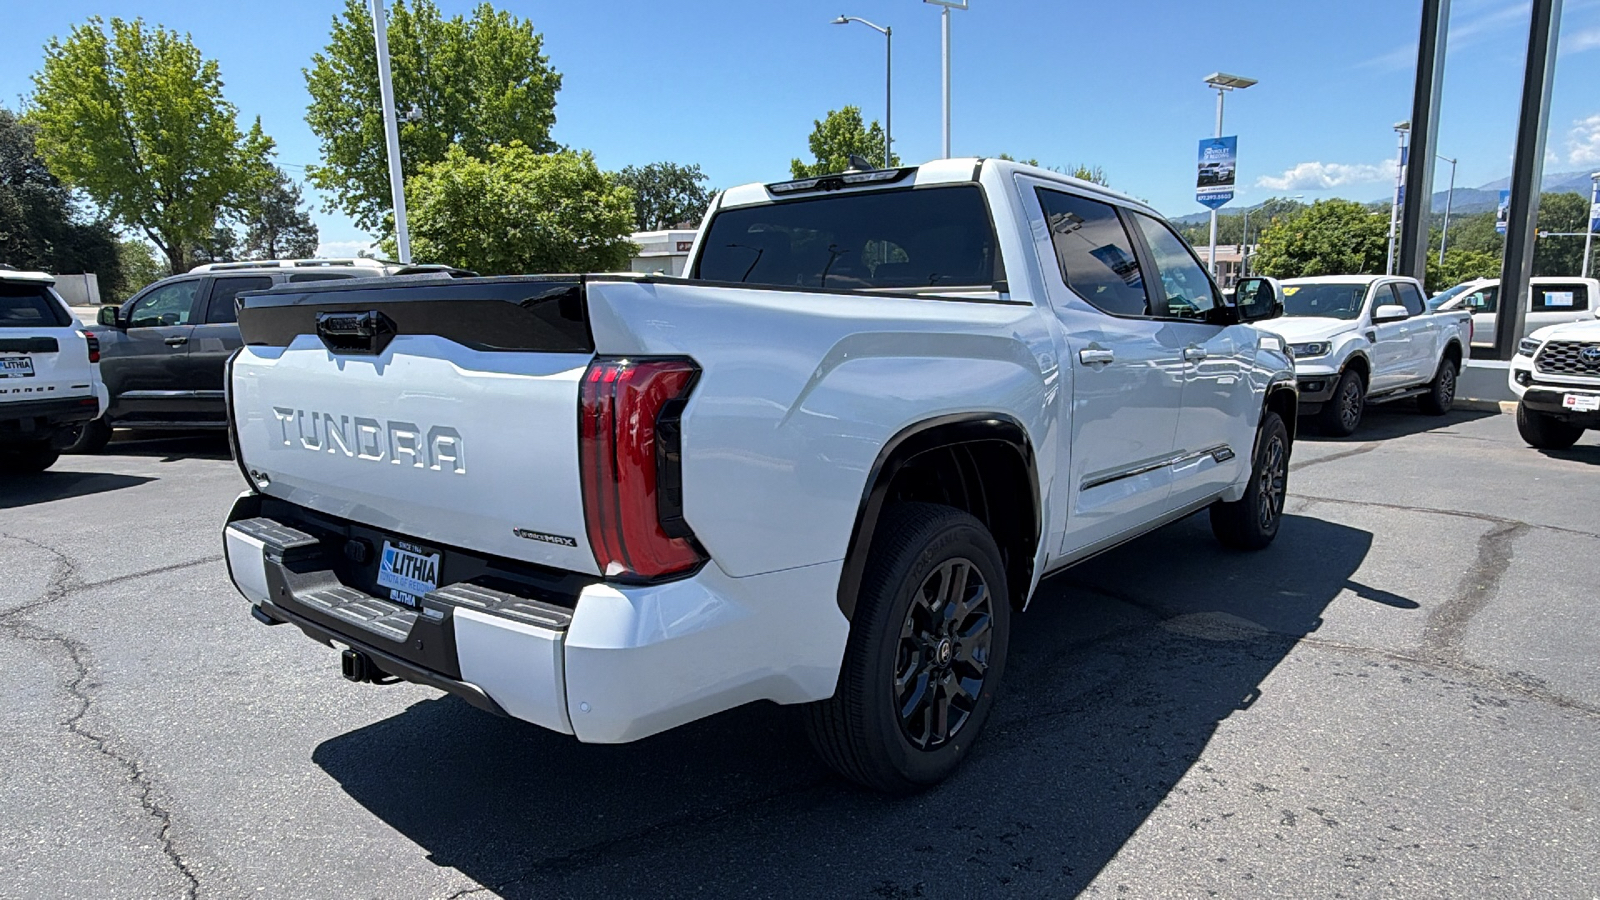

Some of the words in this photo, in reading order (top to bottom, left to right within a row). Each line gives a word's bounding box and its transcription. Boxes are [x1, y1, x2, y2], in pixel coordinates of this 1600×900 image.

[3, 361, 31, 369] LITHIA
[272, 406, 466, 474] TUNDRA
[392, 551, 436, 586] LITHIA
[396, 590, 416, 607] LITHIA
